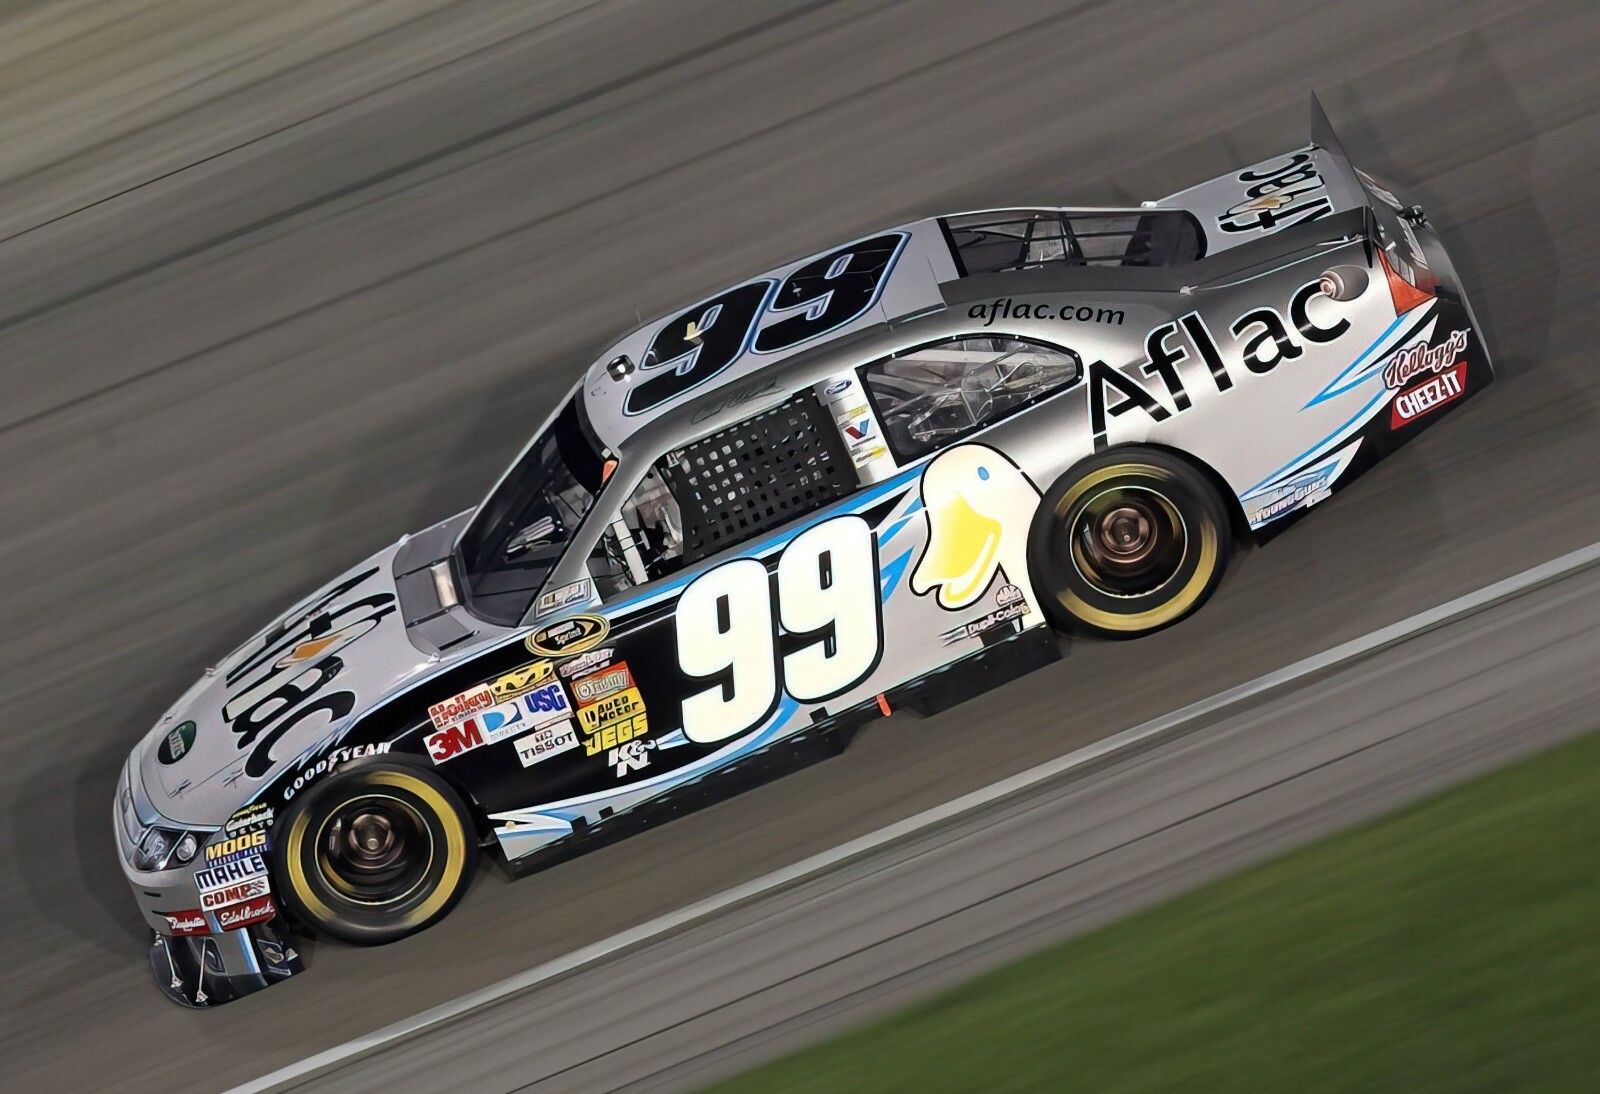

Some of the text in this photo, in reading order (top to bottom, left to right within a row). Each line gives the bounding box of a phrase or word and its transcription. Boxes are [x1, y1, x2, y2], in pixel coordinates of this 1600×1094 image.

[622, 232, 912, 415] 99
[967, 298, 1125, 327] aflac.com
[1088, 279, 1351, 454] Aflac
[1382, 329, 1469, 390] Kellogg's
[1395, 370, 1462, 419] CHEEZ-IT
[675, 515, 878, 744] 99
[523, 683, 567, 713] USG
[427, 719, 484, 760] 3M
[520, 731, 574, 760] TISSOT
[582, 714, 649, 757] JEGS
[283, 741, 391, 801] GOODYEAR
[205, 829, 267, 862] MOOG
[196, 856, 266, 890] MAHLE
